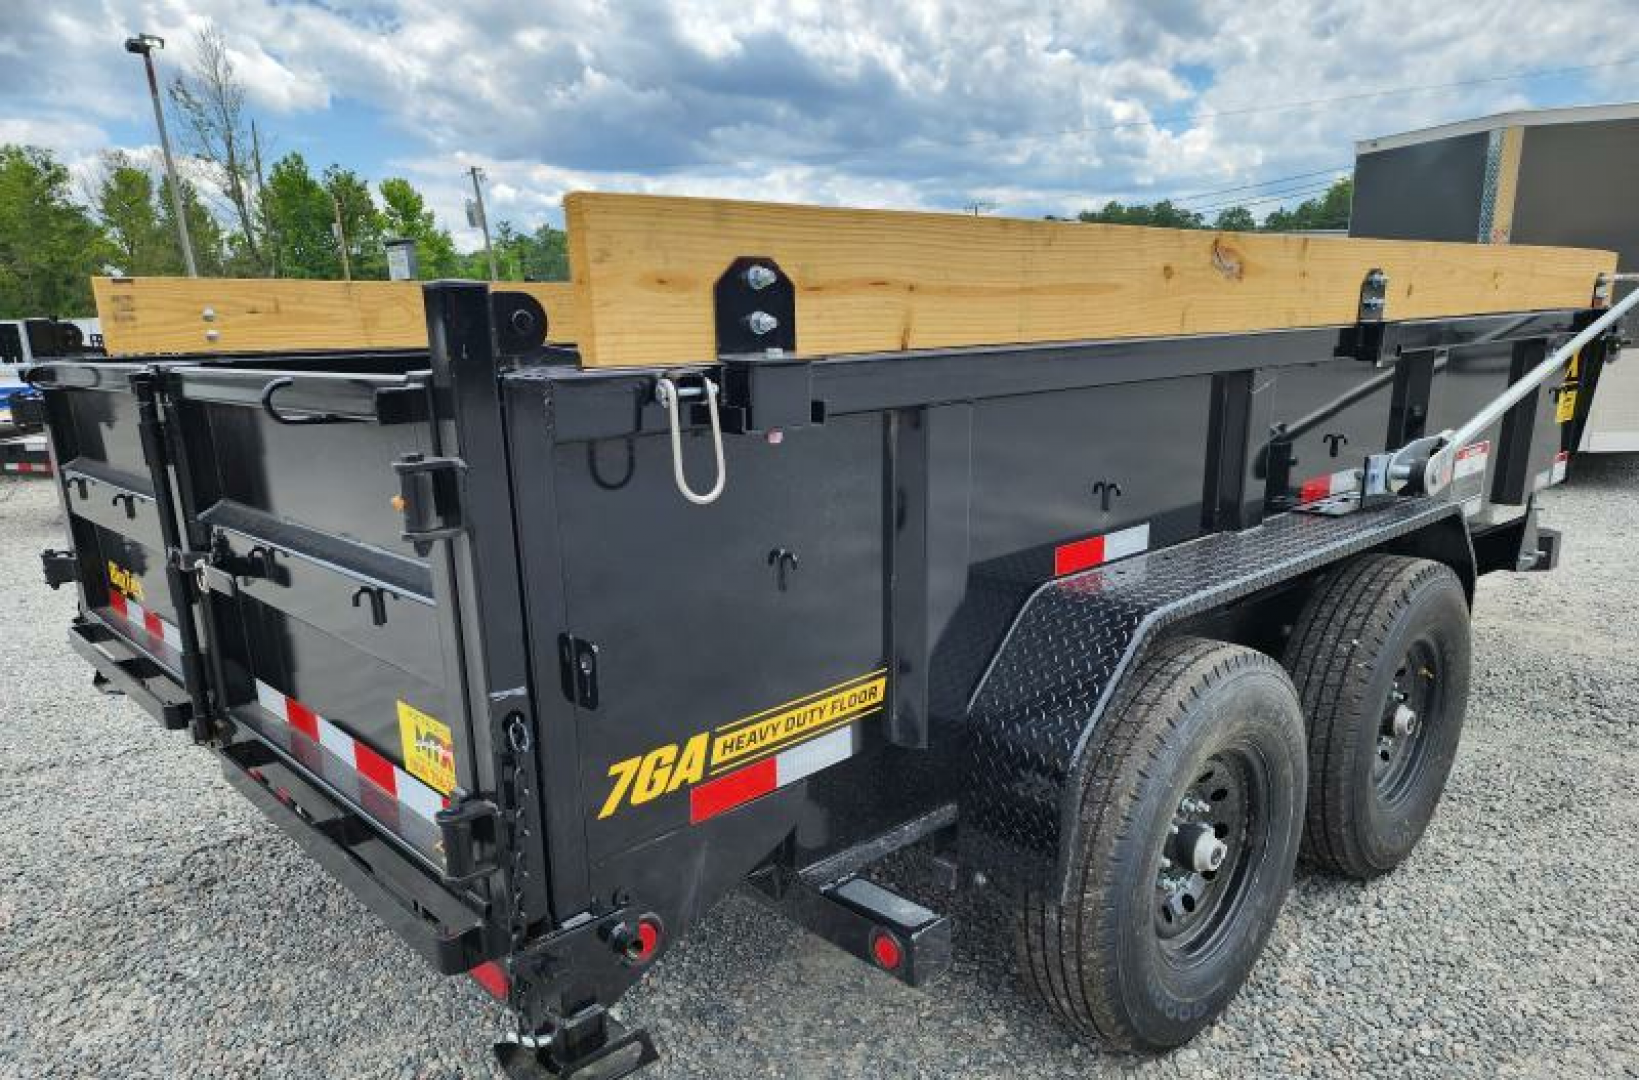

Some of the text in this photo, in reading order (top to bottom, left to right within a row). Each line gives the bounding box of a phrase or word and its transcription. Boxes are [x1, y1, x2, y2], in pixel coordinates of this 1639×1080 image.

[598, 685, 878, 820] 7GA HEAVY DUTY FLOOR
